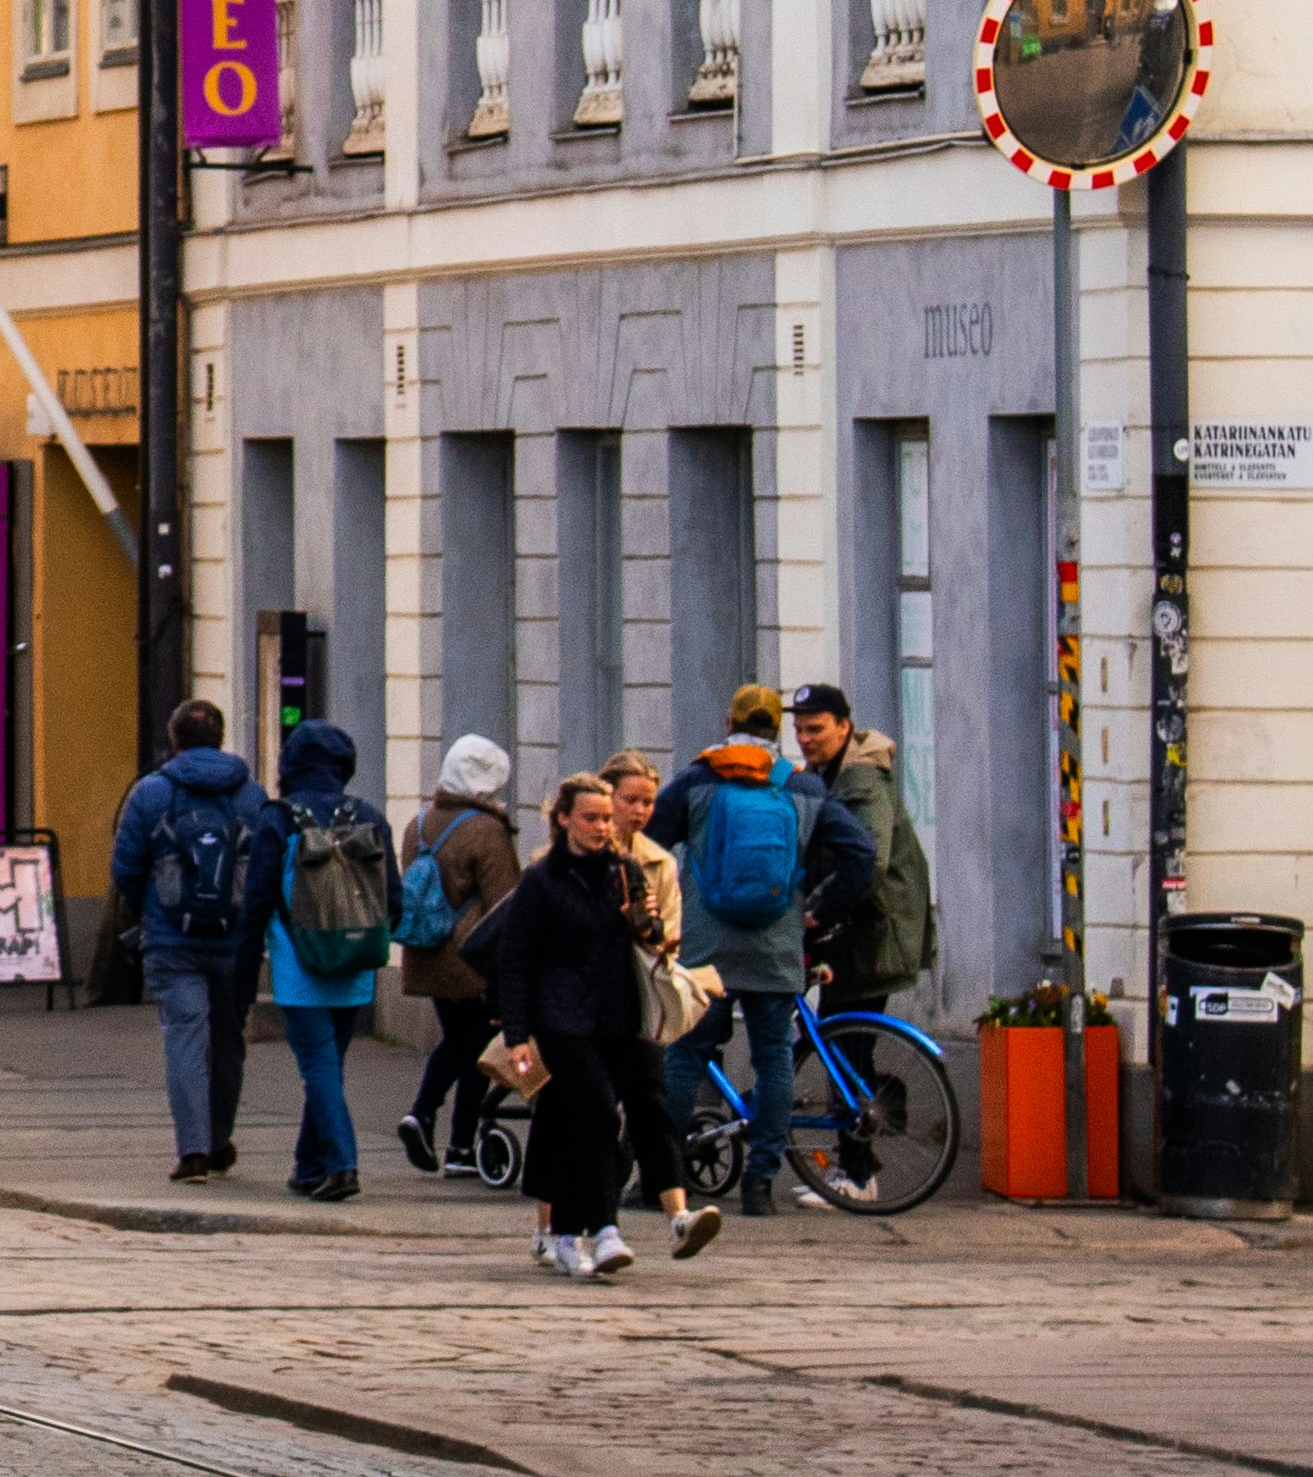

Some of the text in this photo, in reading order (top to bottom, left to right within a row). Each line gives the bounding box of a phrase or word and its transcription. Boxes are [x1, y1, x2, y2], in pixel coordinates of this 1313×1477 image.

[923, 301, 993, 358] museo
[1194, 425, 1311, 441] KATARIINANKATU
[1194, 443, 1296, 459] KATRINEGATAN
